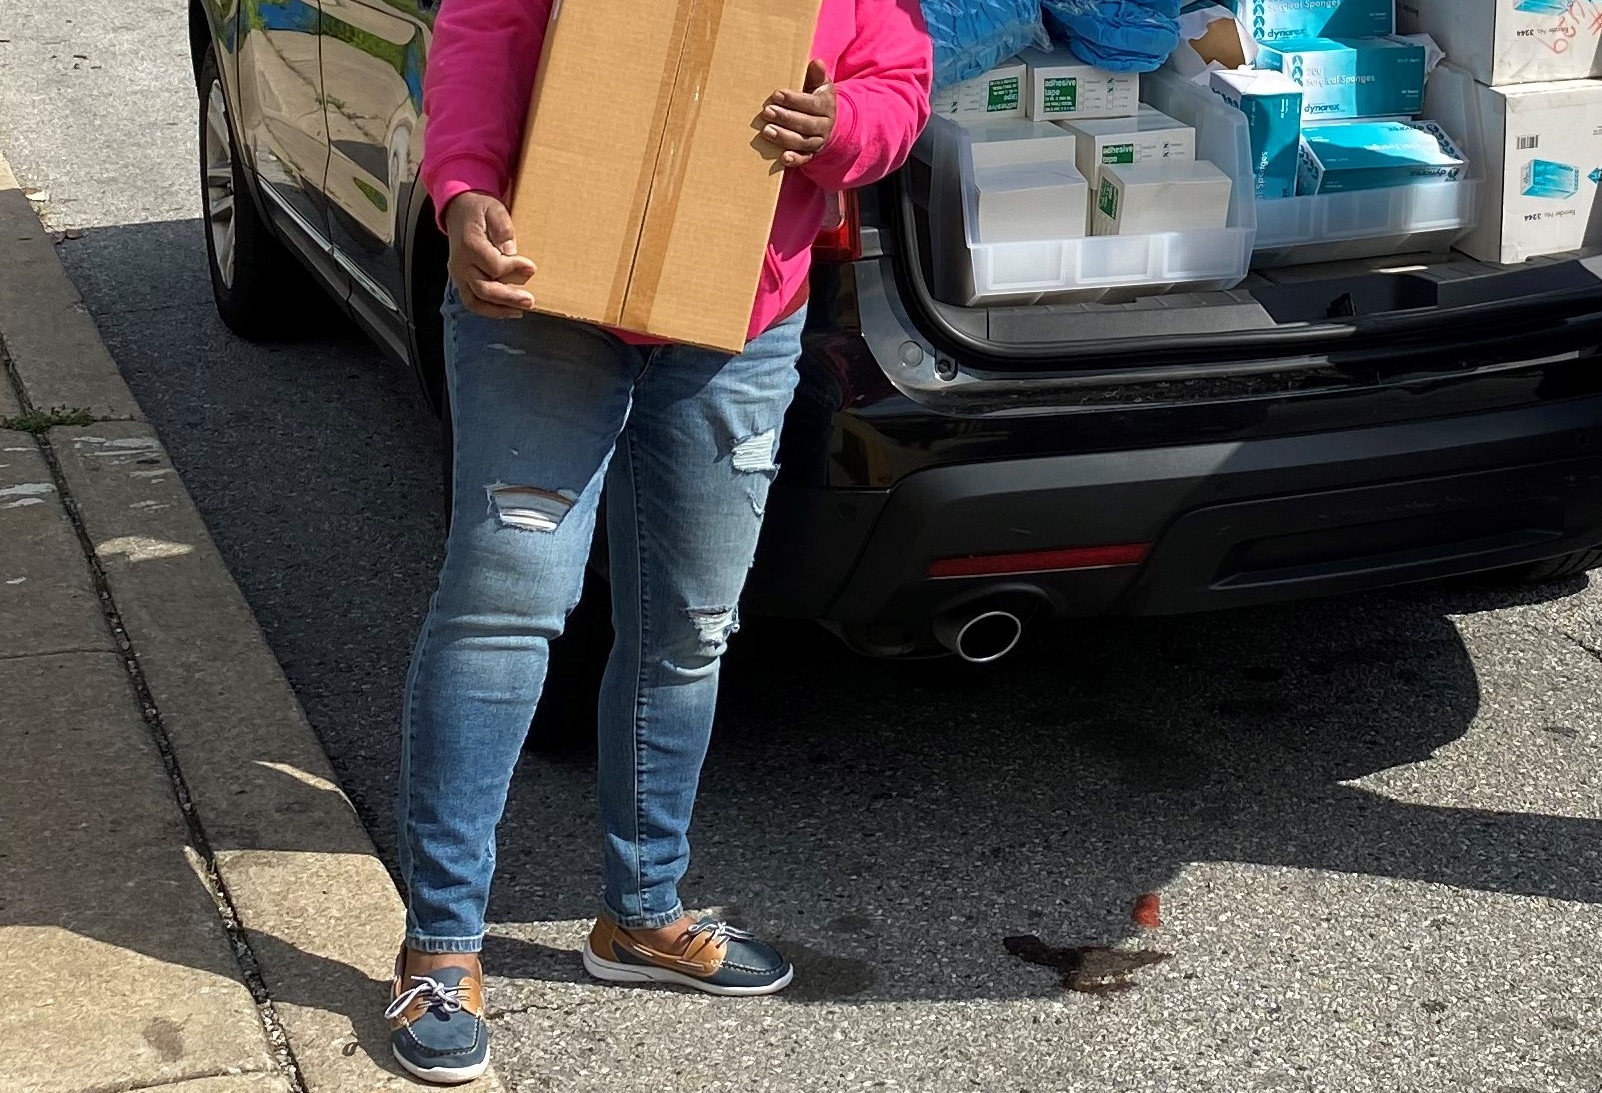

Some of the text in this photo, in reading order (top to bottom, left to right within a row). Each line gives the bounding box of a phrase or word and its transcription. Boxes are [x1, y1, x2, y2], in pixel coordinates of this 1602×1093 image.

[1267, 28, 1307, 39] dynarex
[1341, 73, 1375, 85] Sponges
[1304, 103, 1340, 115] dynarex
